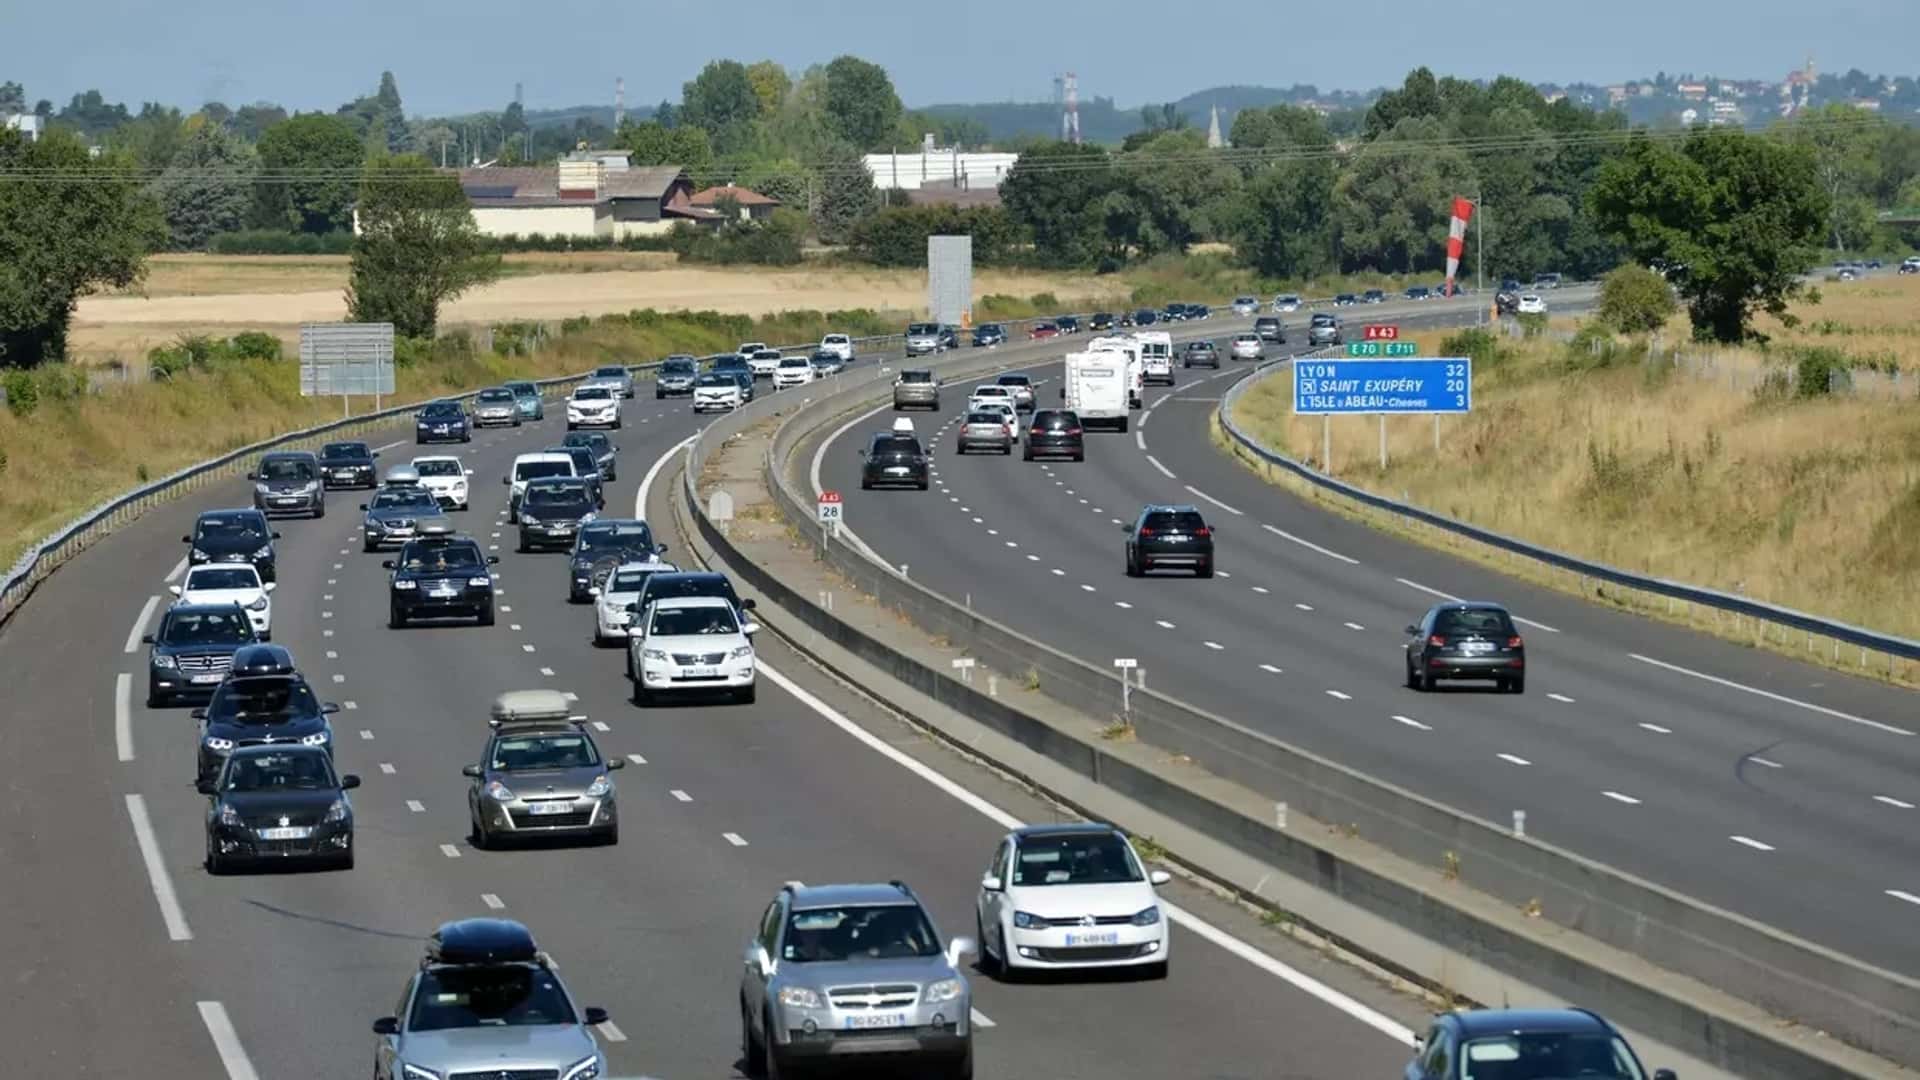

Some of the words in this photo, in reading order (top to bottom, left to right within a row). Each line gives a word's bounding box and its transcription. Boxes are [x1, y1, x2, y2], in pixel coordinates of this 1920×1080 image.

[1369, 328, 1377, 338] A
[1379, 327, 1394, 338] 43
[1351, 344, 1359, 355] E
[1362, 344, 1377, 355] 70
[1386, 344, 1394, 354] E
[1396, 344, 1414, 354] 711
[1300, 365, 1336, 378] LYON
[1446, 364, 1465, 377] 32
[1320, 380, 1360, 393] SAINT
[1364, 376, 1424, 393] EXUPÉRY
[1446, 380, 1465, 392] 20
[1455, 394, 1465, 407] 3
[823, 506, 838, 517] 28
